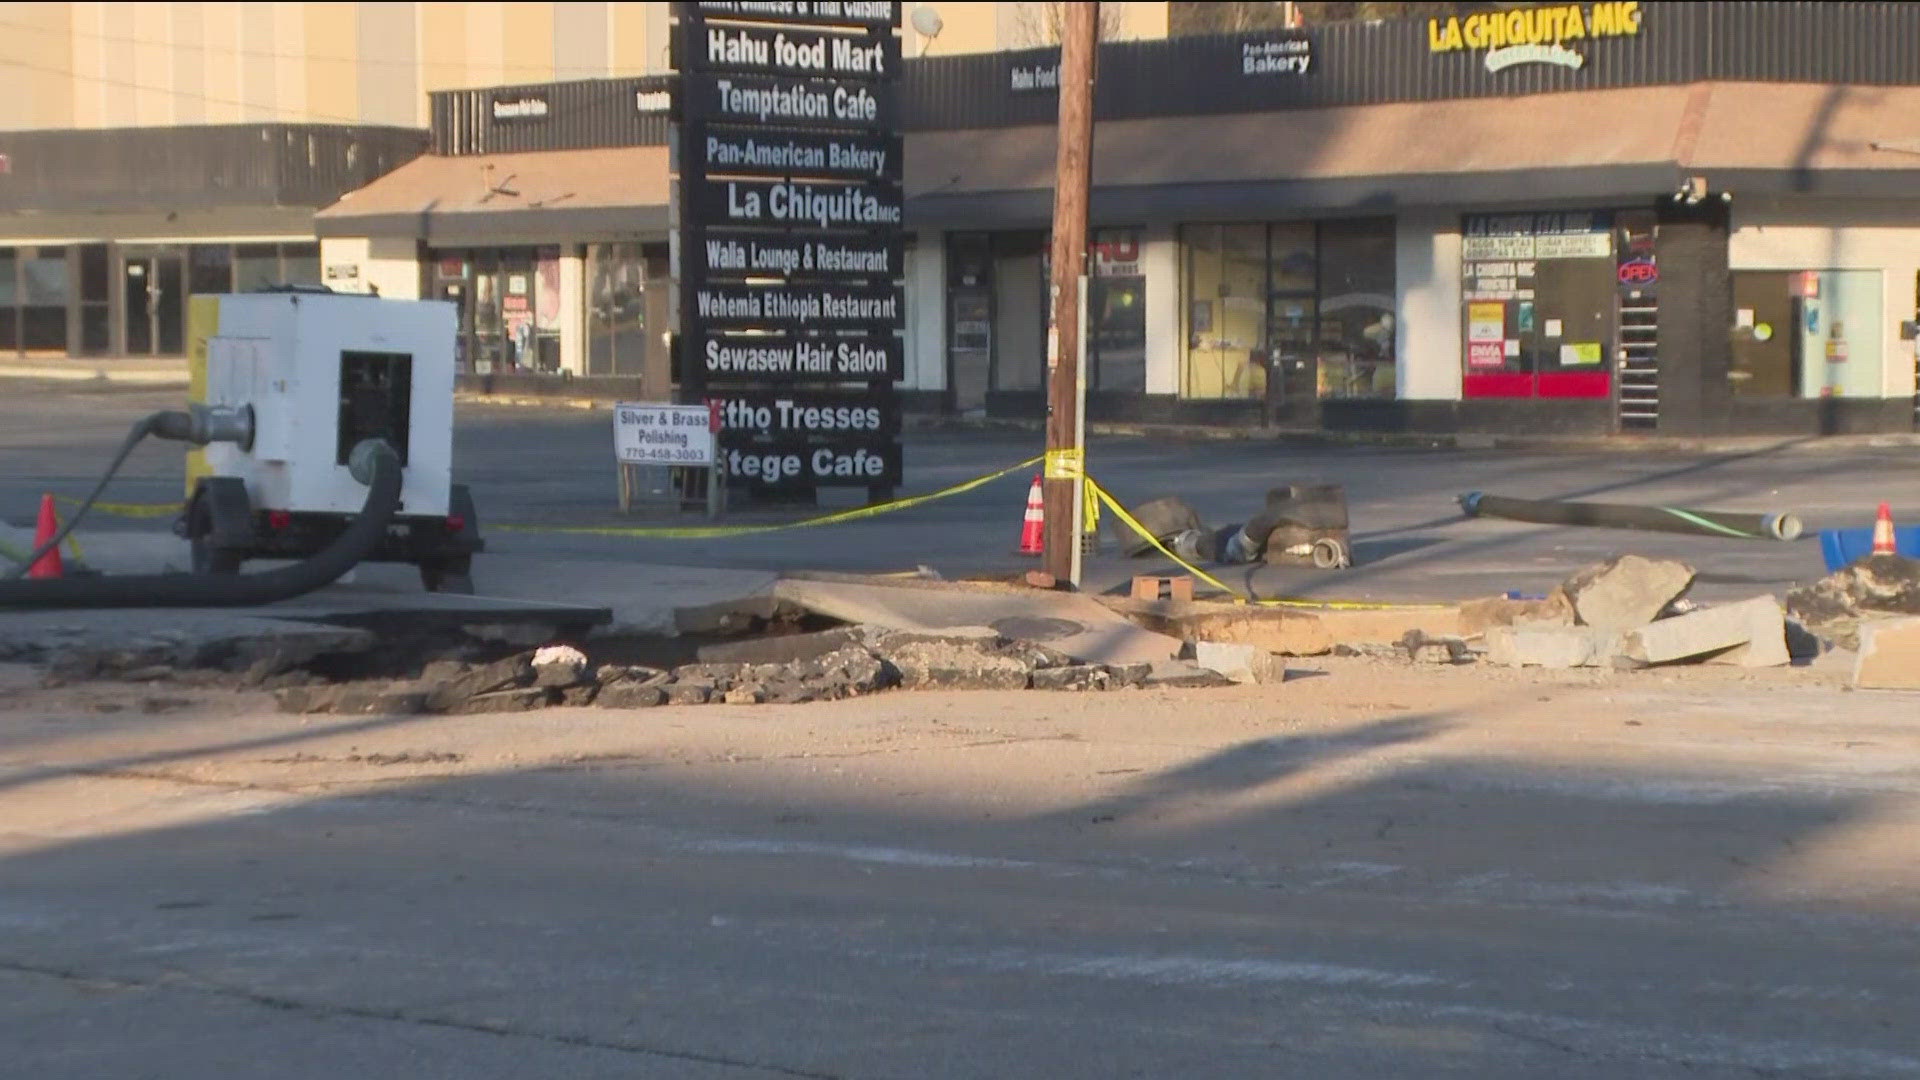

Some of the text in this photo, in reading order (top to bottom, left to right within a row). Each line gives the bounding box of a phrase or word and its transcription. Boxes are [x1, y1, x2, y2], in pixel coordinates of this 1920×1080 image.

[844, 2, 891, 18] Cuisine
[1429, 2, 1639, 51] LA CHIQUITA MIC
[708, 29, 884, 73] Hahu food Mart
[1243, 55, 1310, 74] Bakery
[718, 79, 877, 122] Temptation Cafe
[706, 137, 885, 176] Pan-American Bakery
[728, 182, 760, 218] La
[769, 184, 878, 228] Chiquita
[751, 242, 800, 275] Lounge
[803, 243, 813, 270] &
[817, 245, 888, 272] Restaurant
[1617, 263, 1659, 281] OPEN
[697, 291, 896, 323] Wehemia Ethiopia Restaurant
[706, 340, 887, 373] Sewasew Hair Salon
[621, 411, 708, 426] Silver & Brass
[775, 400, 880, 430] Tresses
[625, 447, 704, 460] 770-458-3003
[639, 429, 688, 448] Polishing
[811, 448, 883, 477] Cafe
